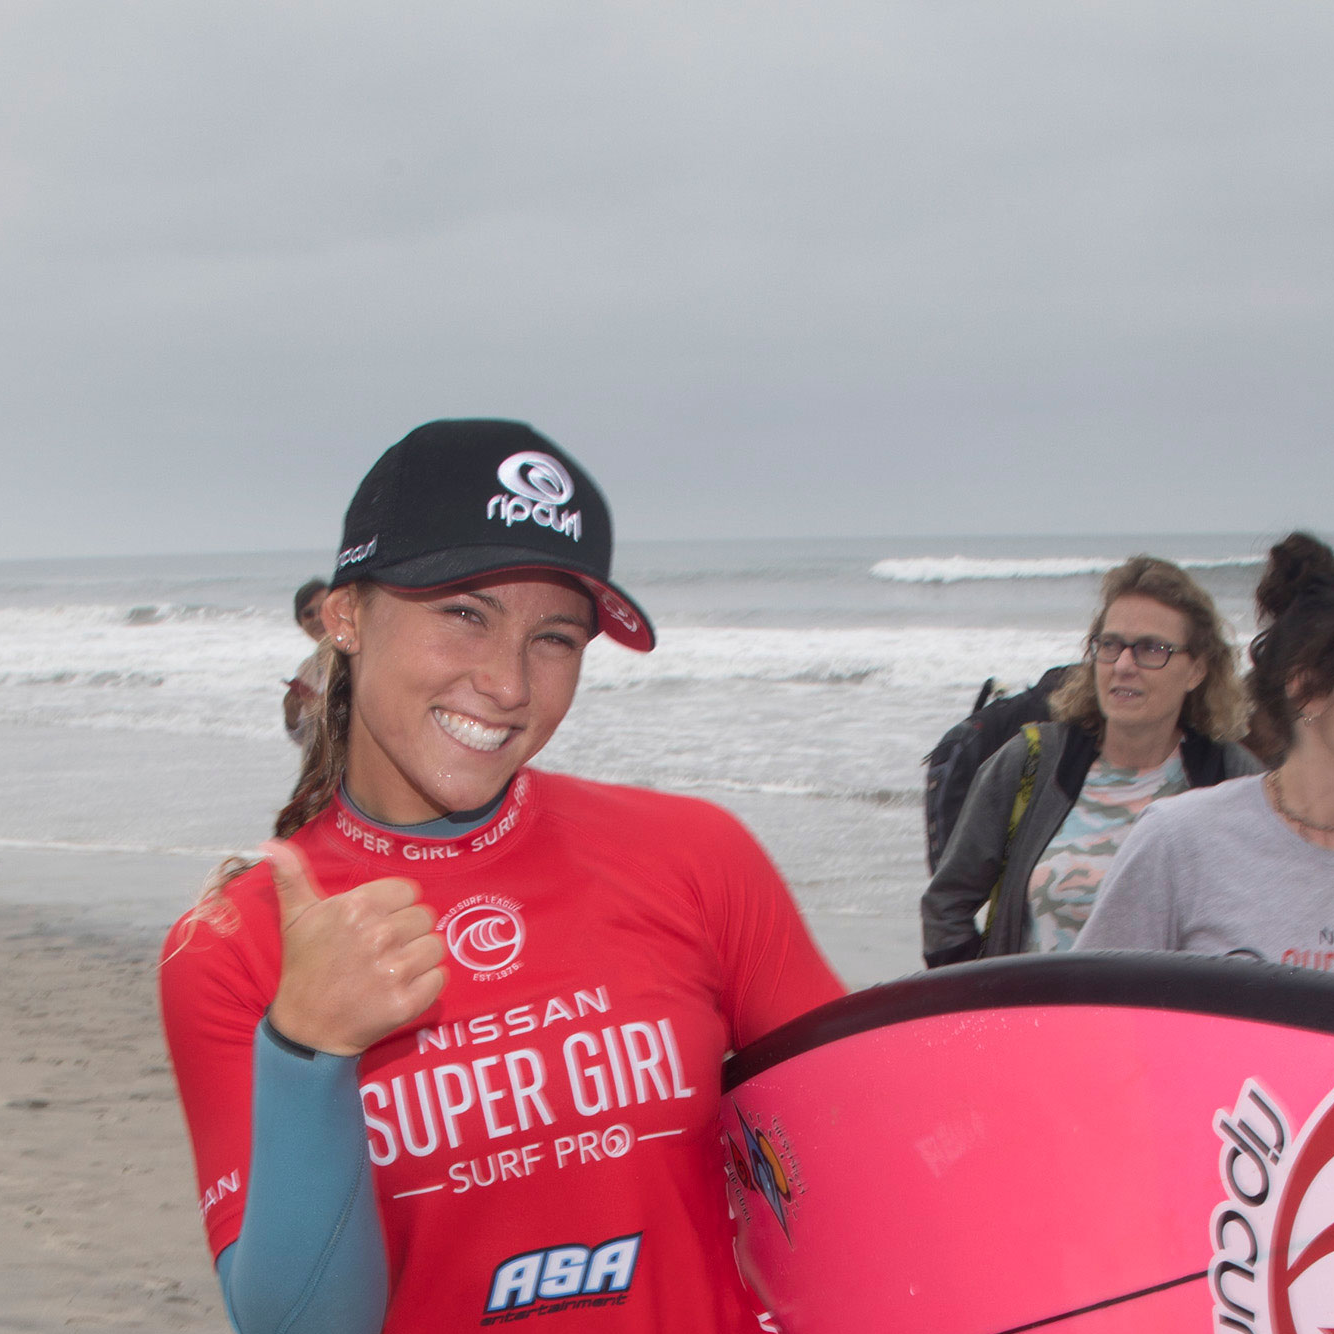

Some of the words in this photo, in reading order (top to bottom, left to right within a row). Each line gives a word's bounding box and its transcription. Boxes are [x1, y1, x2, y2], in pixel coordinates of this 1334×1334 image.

[335, 811, 396, 856] SUPER
[402, 843, 460, 861] GIRL
[471, 805, 524, 853] SURF
[435, 906, 459, 931] WORLD
[457, 892, 484, 911] SURF
[485, 893, 523, 913] LEAGUE
[417, 984, 612, 1055] NISSAN
[359, 1045, 558, 1167] SUPER
[562, 1017, 697, 1117] GIRL
[448, 1142, 546, 1194] SURF
[555, 1123, 635, 1169] PRO
[484, 1232, 643, 1314] ASA
[480, 1293, 628, 1327] entertainment
